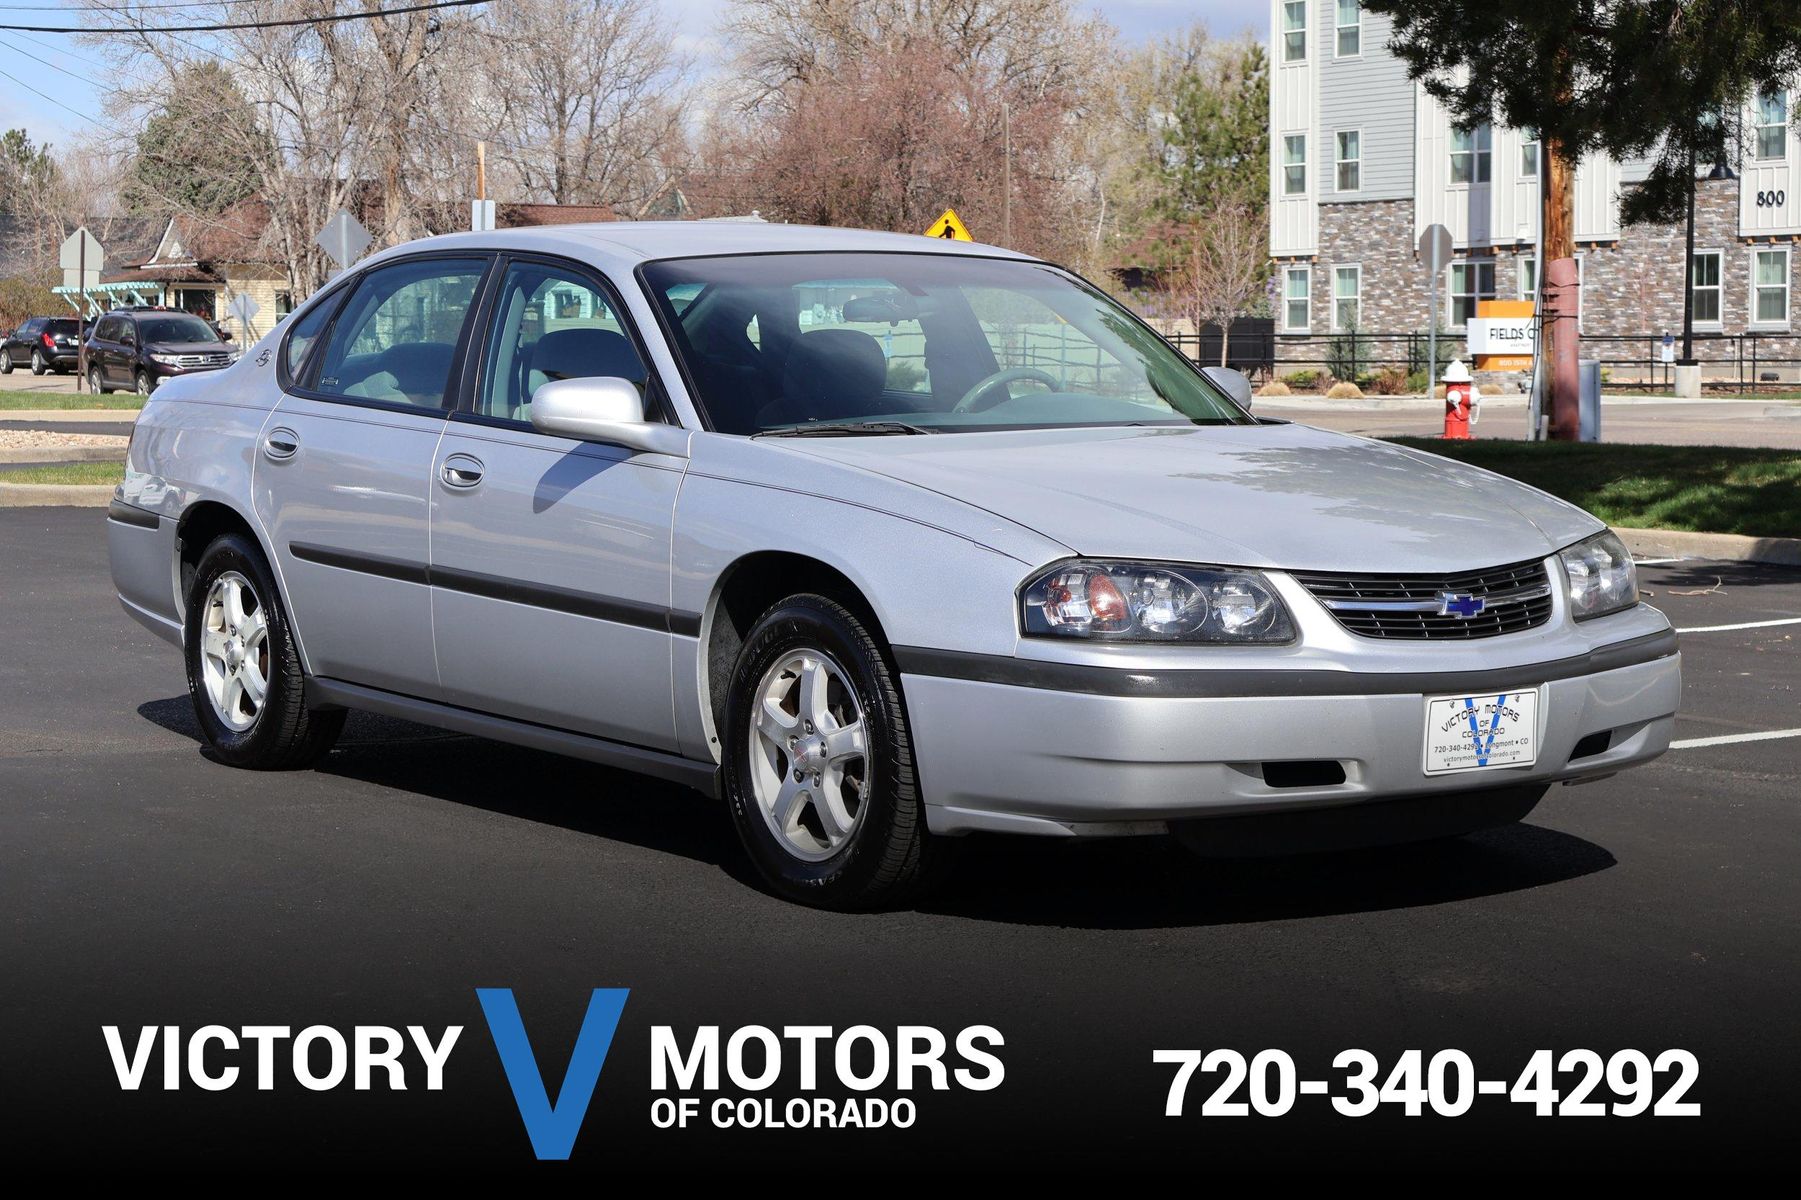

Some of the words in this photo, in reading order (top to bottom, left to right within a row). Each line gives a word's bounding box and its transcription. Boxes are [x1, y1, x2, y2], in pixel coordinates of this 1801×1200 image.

[1757, 190, 1785, 206] 800
[1490, 328, 1524, 340] FIELDS
[1441, 705, 1480, 733] VICTORY
[1484, 704, 1520, 723] MOTORS
[1462, 727, 1505, 739] COLORADO
